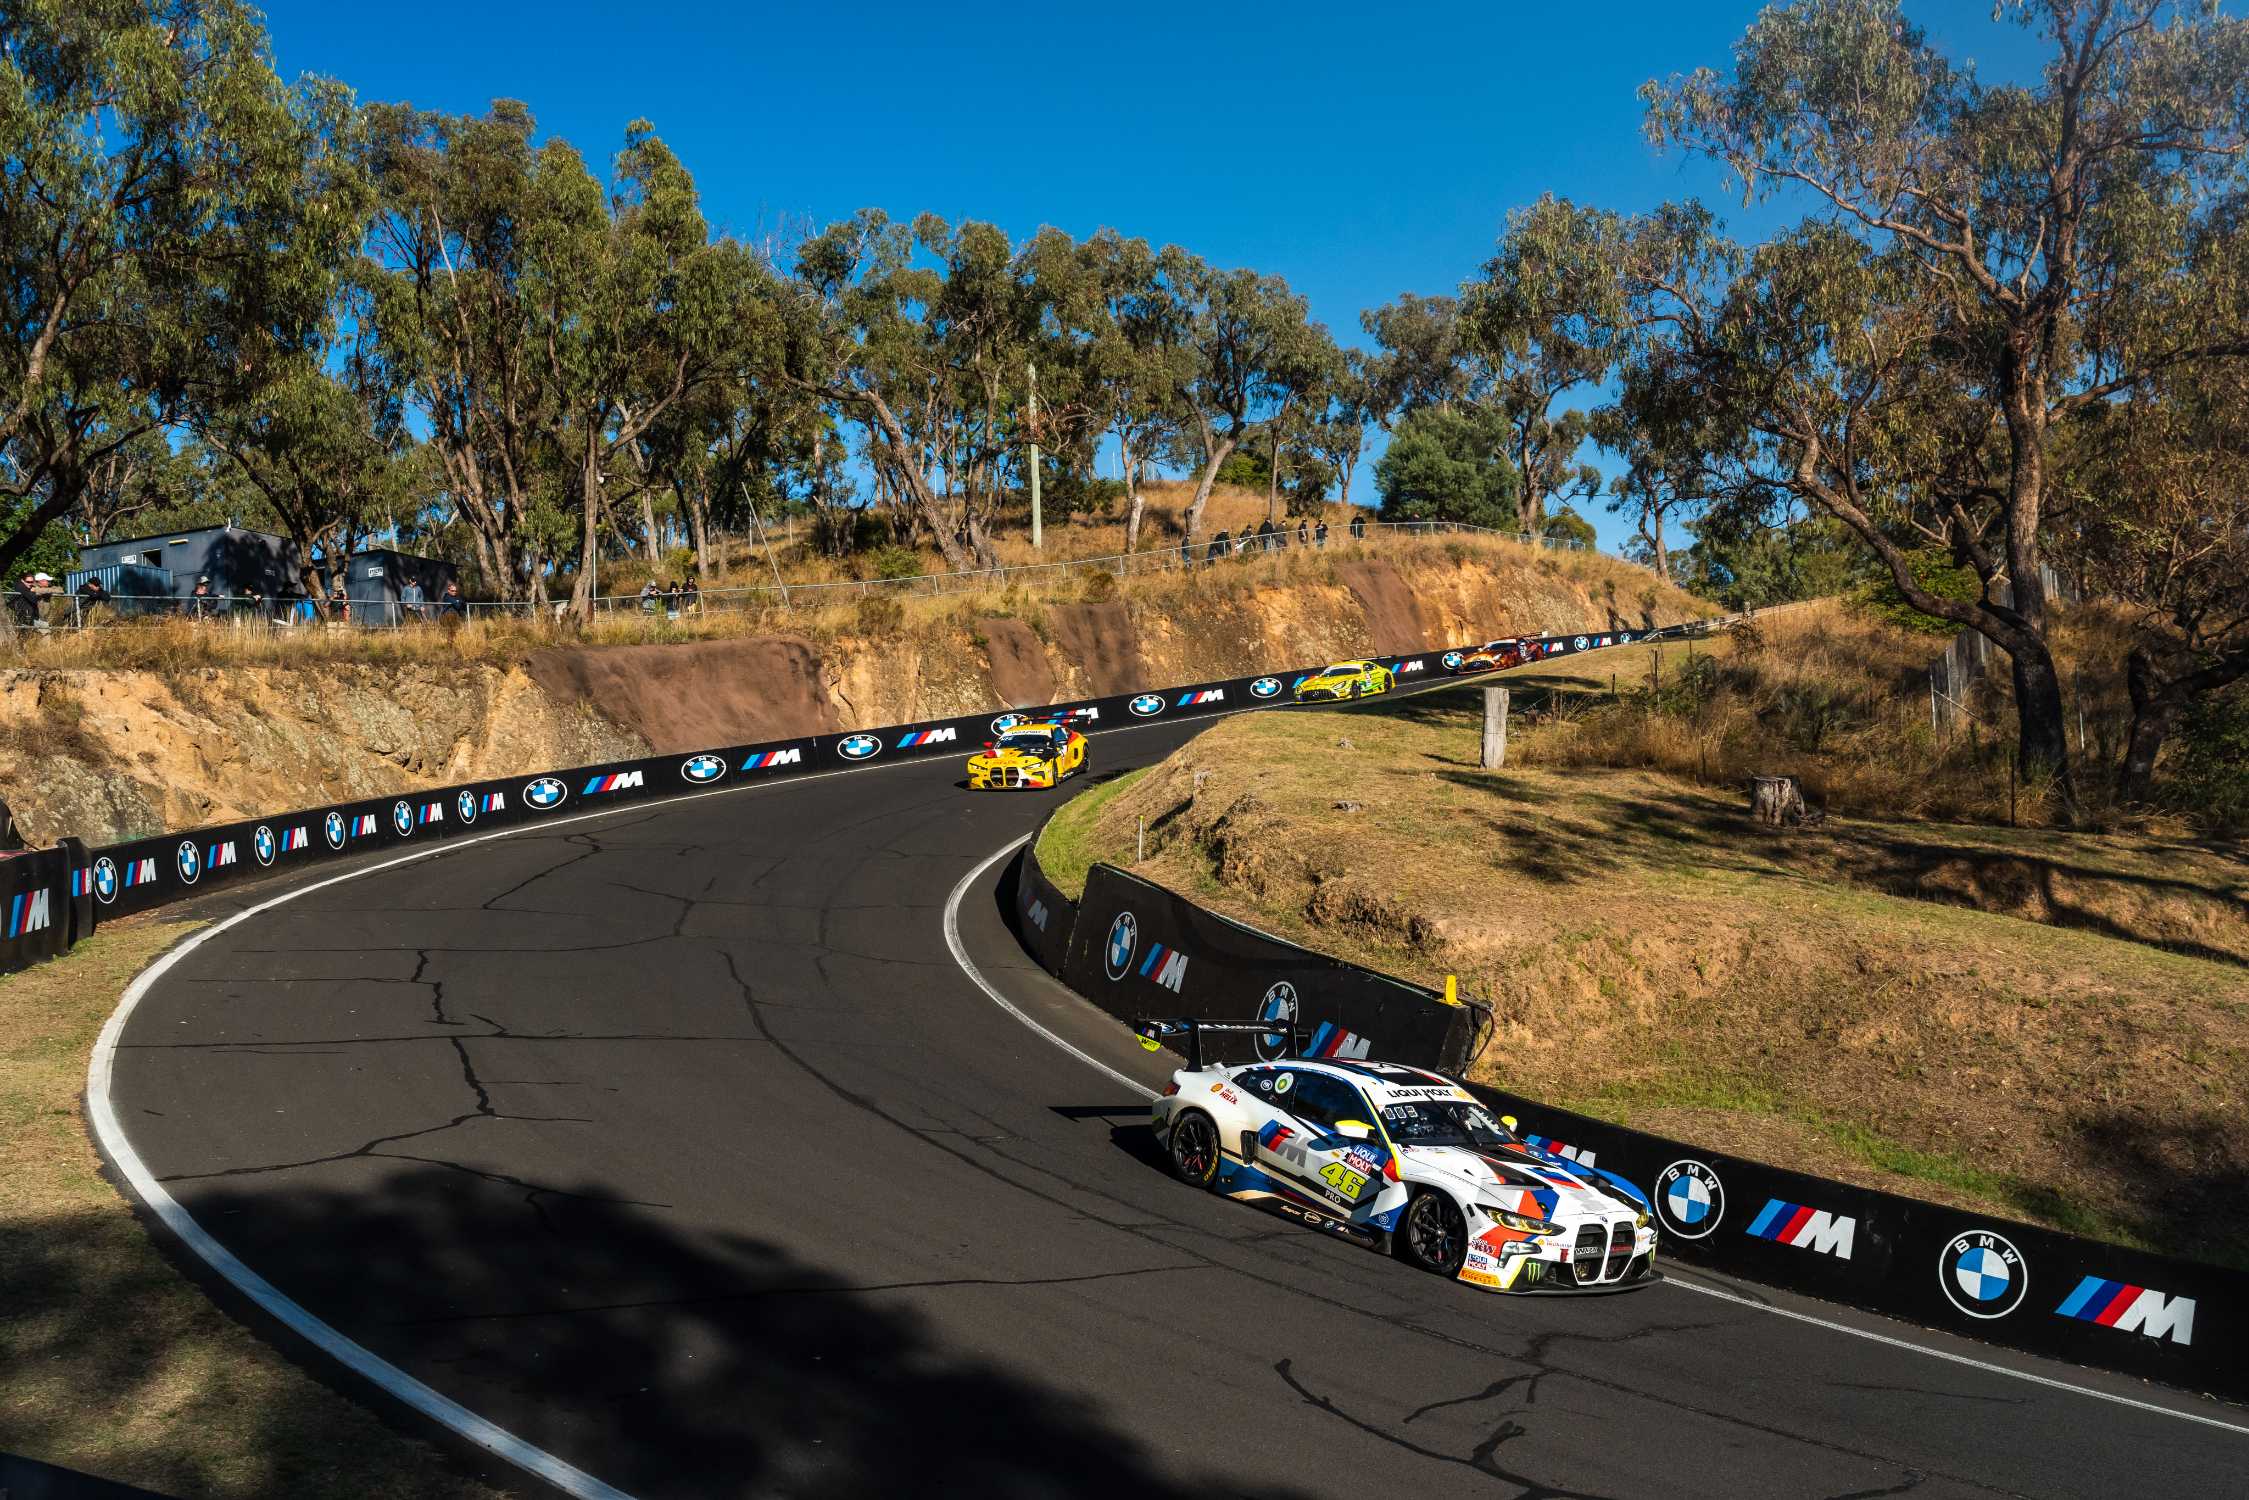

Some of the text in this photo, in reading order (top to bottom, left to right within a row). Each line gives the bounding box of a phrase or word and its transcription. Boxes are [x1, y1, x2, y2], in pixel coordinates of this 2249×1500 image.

[1028, 899, 1048, 932] M
[1156, 950, 1189, 994] M
[1219, 1091, 1238, 1105] HELIX
[1386, 1089, 1421, 1098] LIQUI
[1421, 1088, 1453, 1097] MOLY
[1348, 1153, 1372, 1174] MOLY
[1353, 1144, 1378, 1164] LIQUI
[1319, 1161, 1367, 1200] 46
[1324, 1189, 1341, 1204] PRO
[1790, 1209, 1856, 1260] M
[1468, 1260, 1487, 1270] MOLY
[1469, 1253, 1488, 1263] LIQUI
[2112, 1288, 2196, 1346] M
